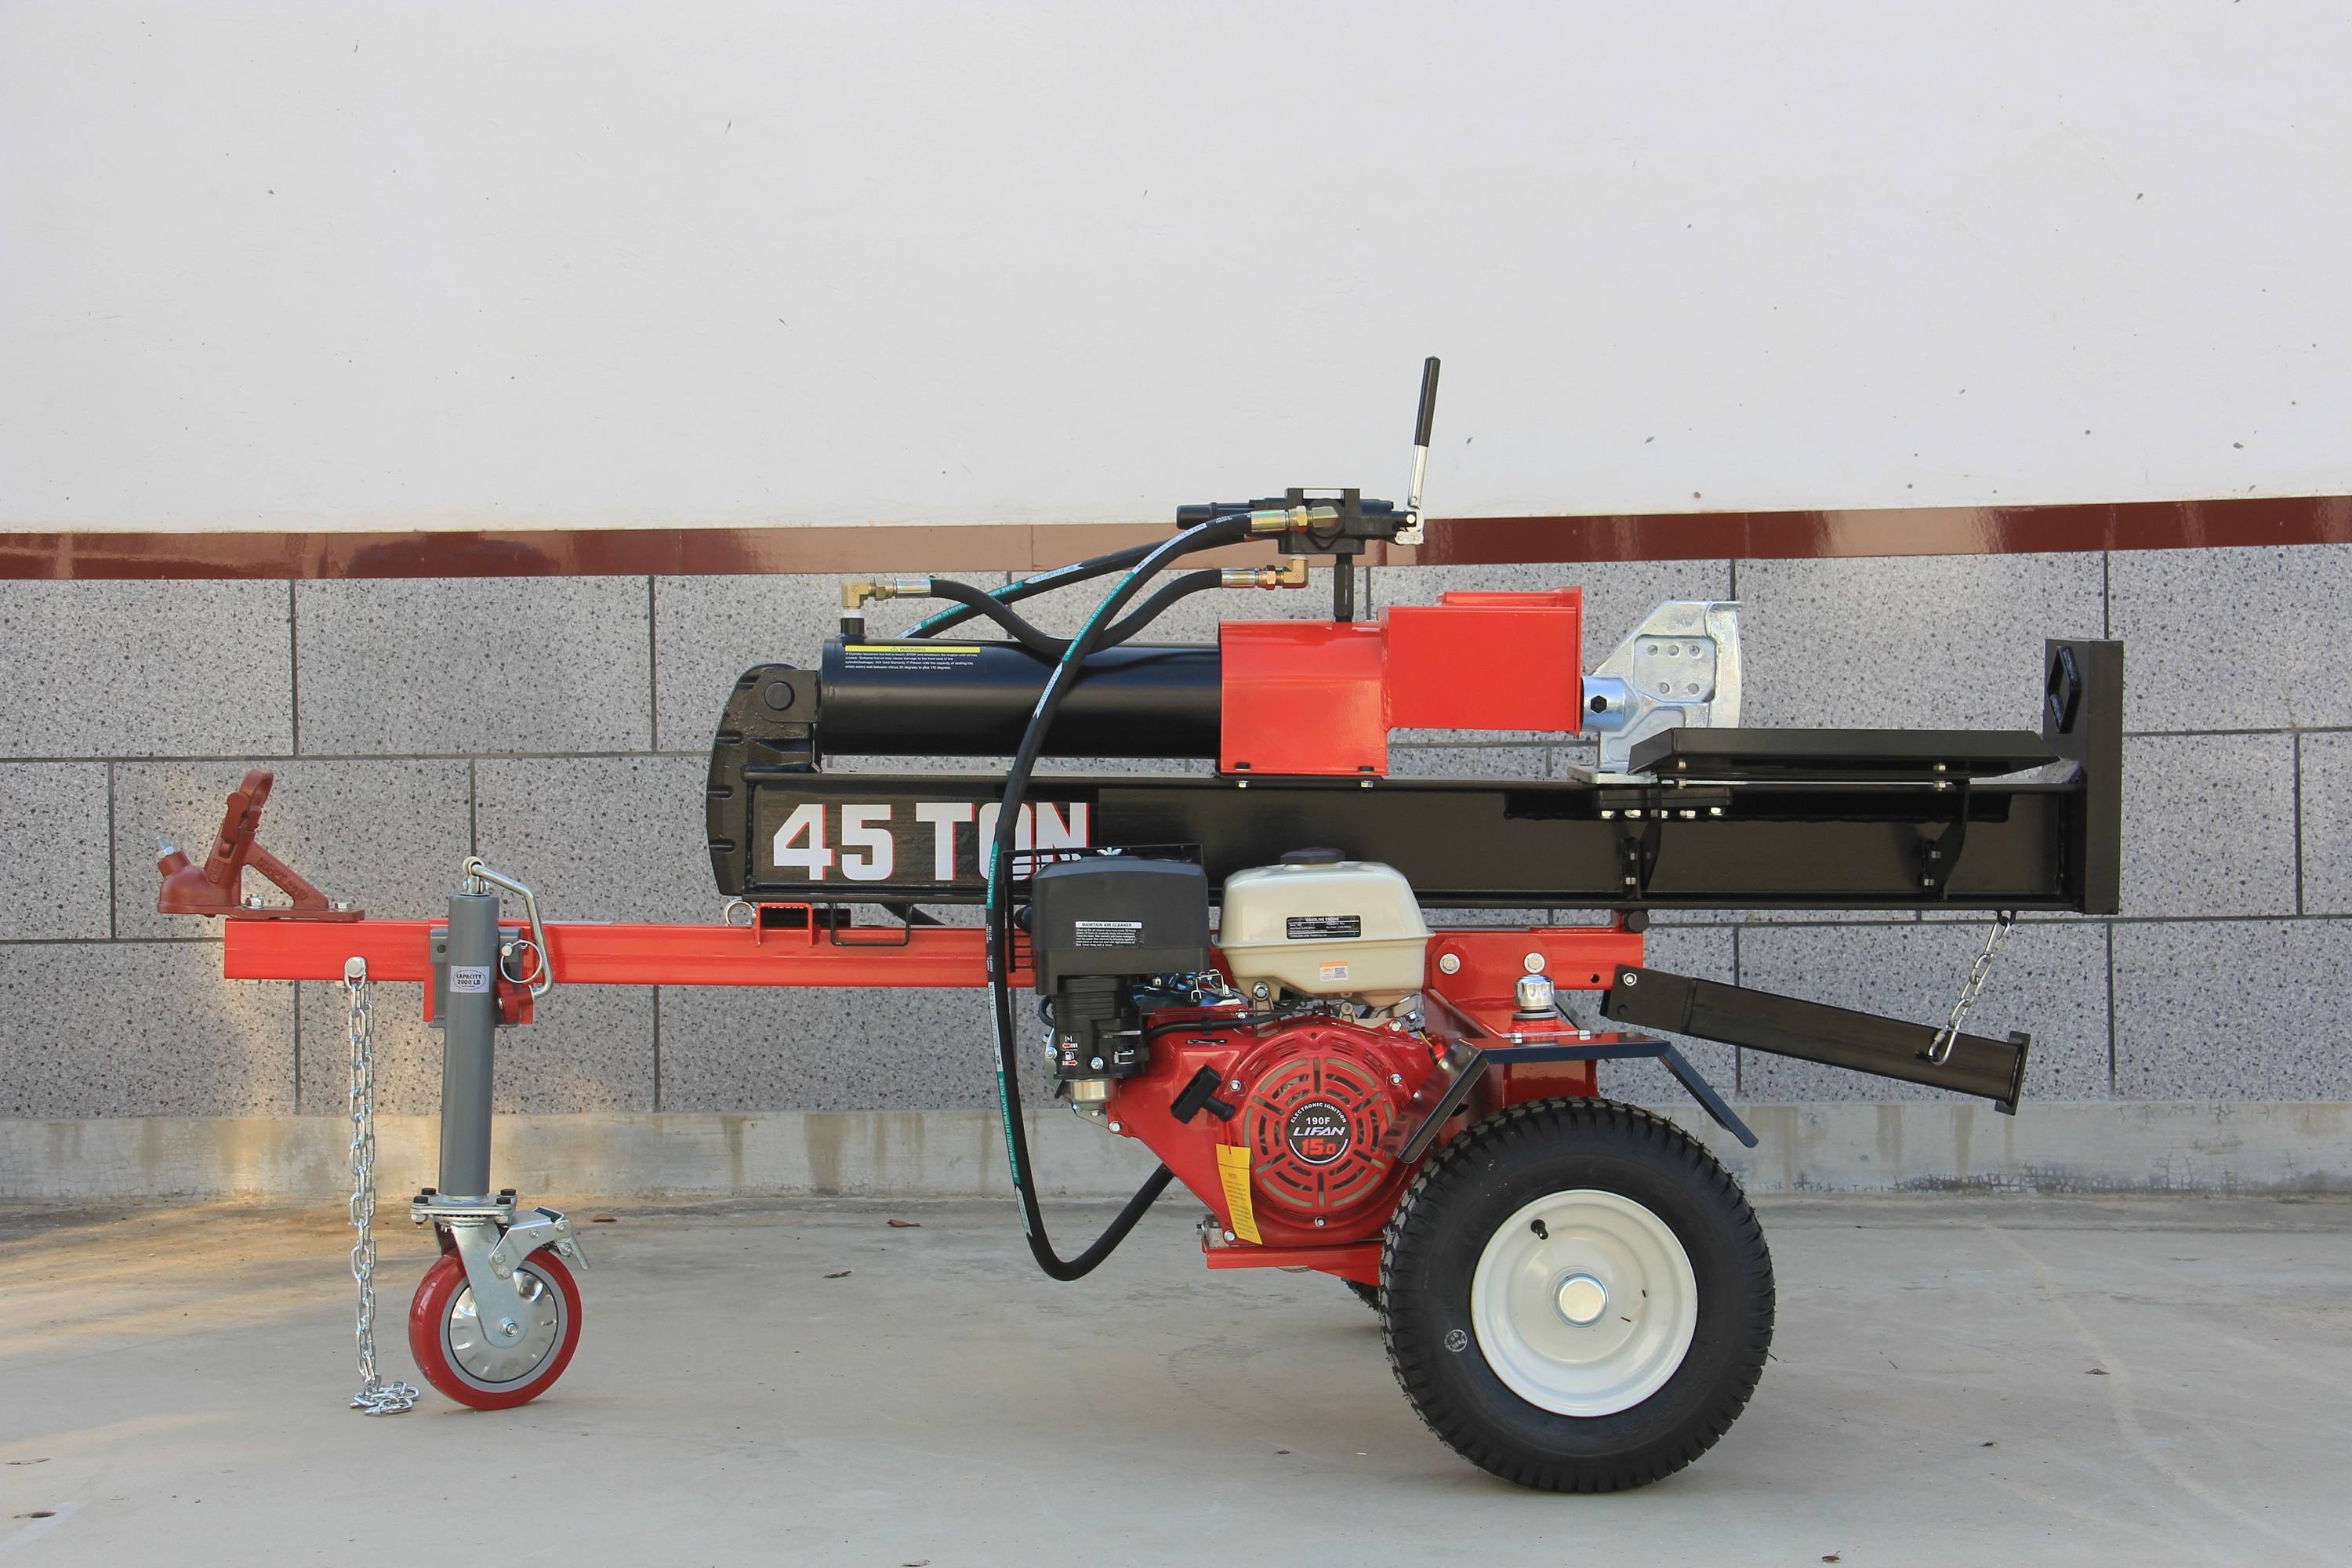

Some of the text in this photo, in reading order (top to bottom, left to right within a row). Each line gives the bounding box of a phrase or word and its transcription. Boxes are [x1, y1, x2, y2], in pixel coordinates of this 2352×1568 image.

[1002, 583, 1018, 593] WIRE
[925, 613, 942, 625] HOSE
[1066, 575, 1130, 655] WIRE BRAIDED HYDRAULIC HOSE
[773, 802, 1090, 880] 45 TON
[1000, 1097, 1011, 1133] HYDRAULIC
[1290, 1102, 1348, 1123] ELECTRONIC IGNITION
[1305, 1116, 1330, 1125] 190F
[1293, 1127, 1346, 1136] LIFAN
[1007, 1134, 1015, 1161] BRAIDED
[1301, 1138, 1337, 1156] 15.0
